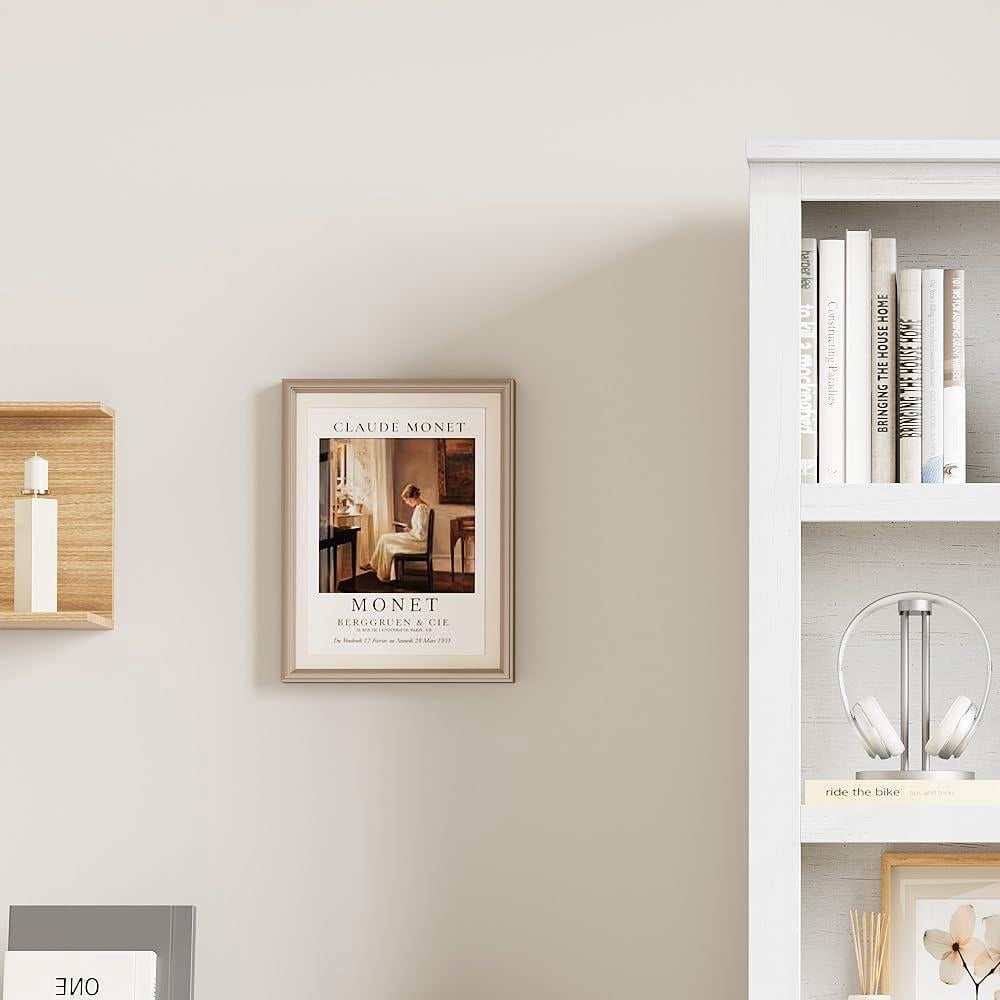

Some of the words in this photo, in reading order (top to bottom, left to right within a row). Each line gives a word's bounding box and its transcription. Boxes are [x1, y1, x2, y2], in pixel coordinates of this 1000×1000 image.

[801, 278, 814, 290] lee
[878, 294, 888, 322] HOME
[826, 301, 838, 362] Constructing
[878, 326, 888, 358] HOUSE
[900, 319, 920, 342] HOME
[900, 346, 920, 373] HOUSE
[878, 362, 888, 382] THE
[828, 366, 838, 406] Paradies
[900, 377, 920, 392] THE
[878, 385, 888, 432] BRINGING
[900, 396, 920, 438] BRINGING
[333, 422, 399, 433] CLAUDE
[407, 422, 466, 433] MONET
[352, 598, 439, 612] MONET
[337, 618, 411, 626] BERGGRUEN
[417, 618, 423, 626] &
[429, 618, 449, 626] CIE
[826, 788, 848, 796] ride
[852, 788, 871, 796] the
[875, 788, 900, 796] bike
